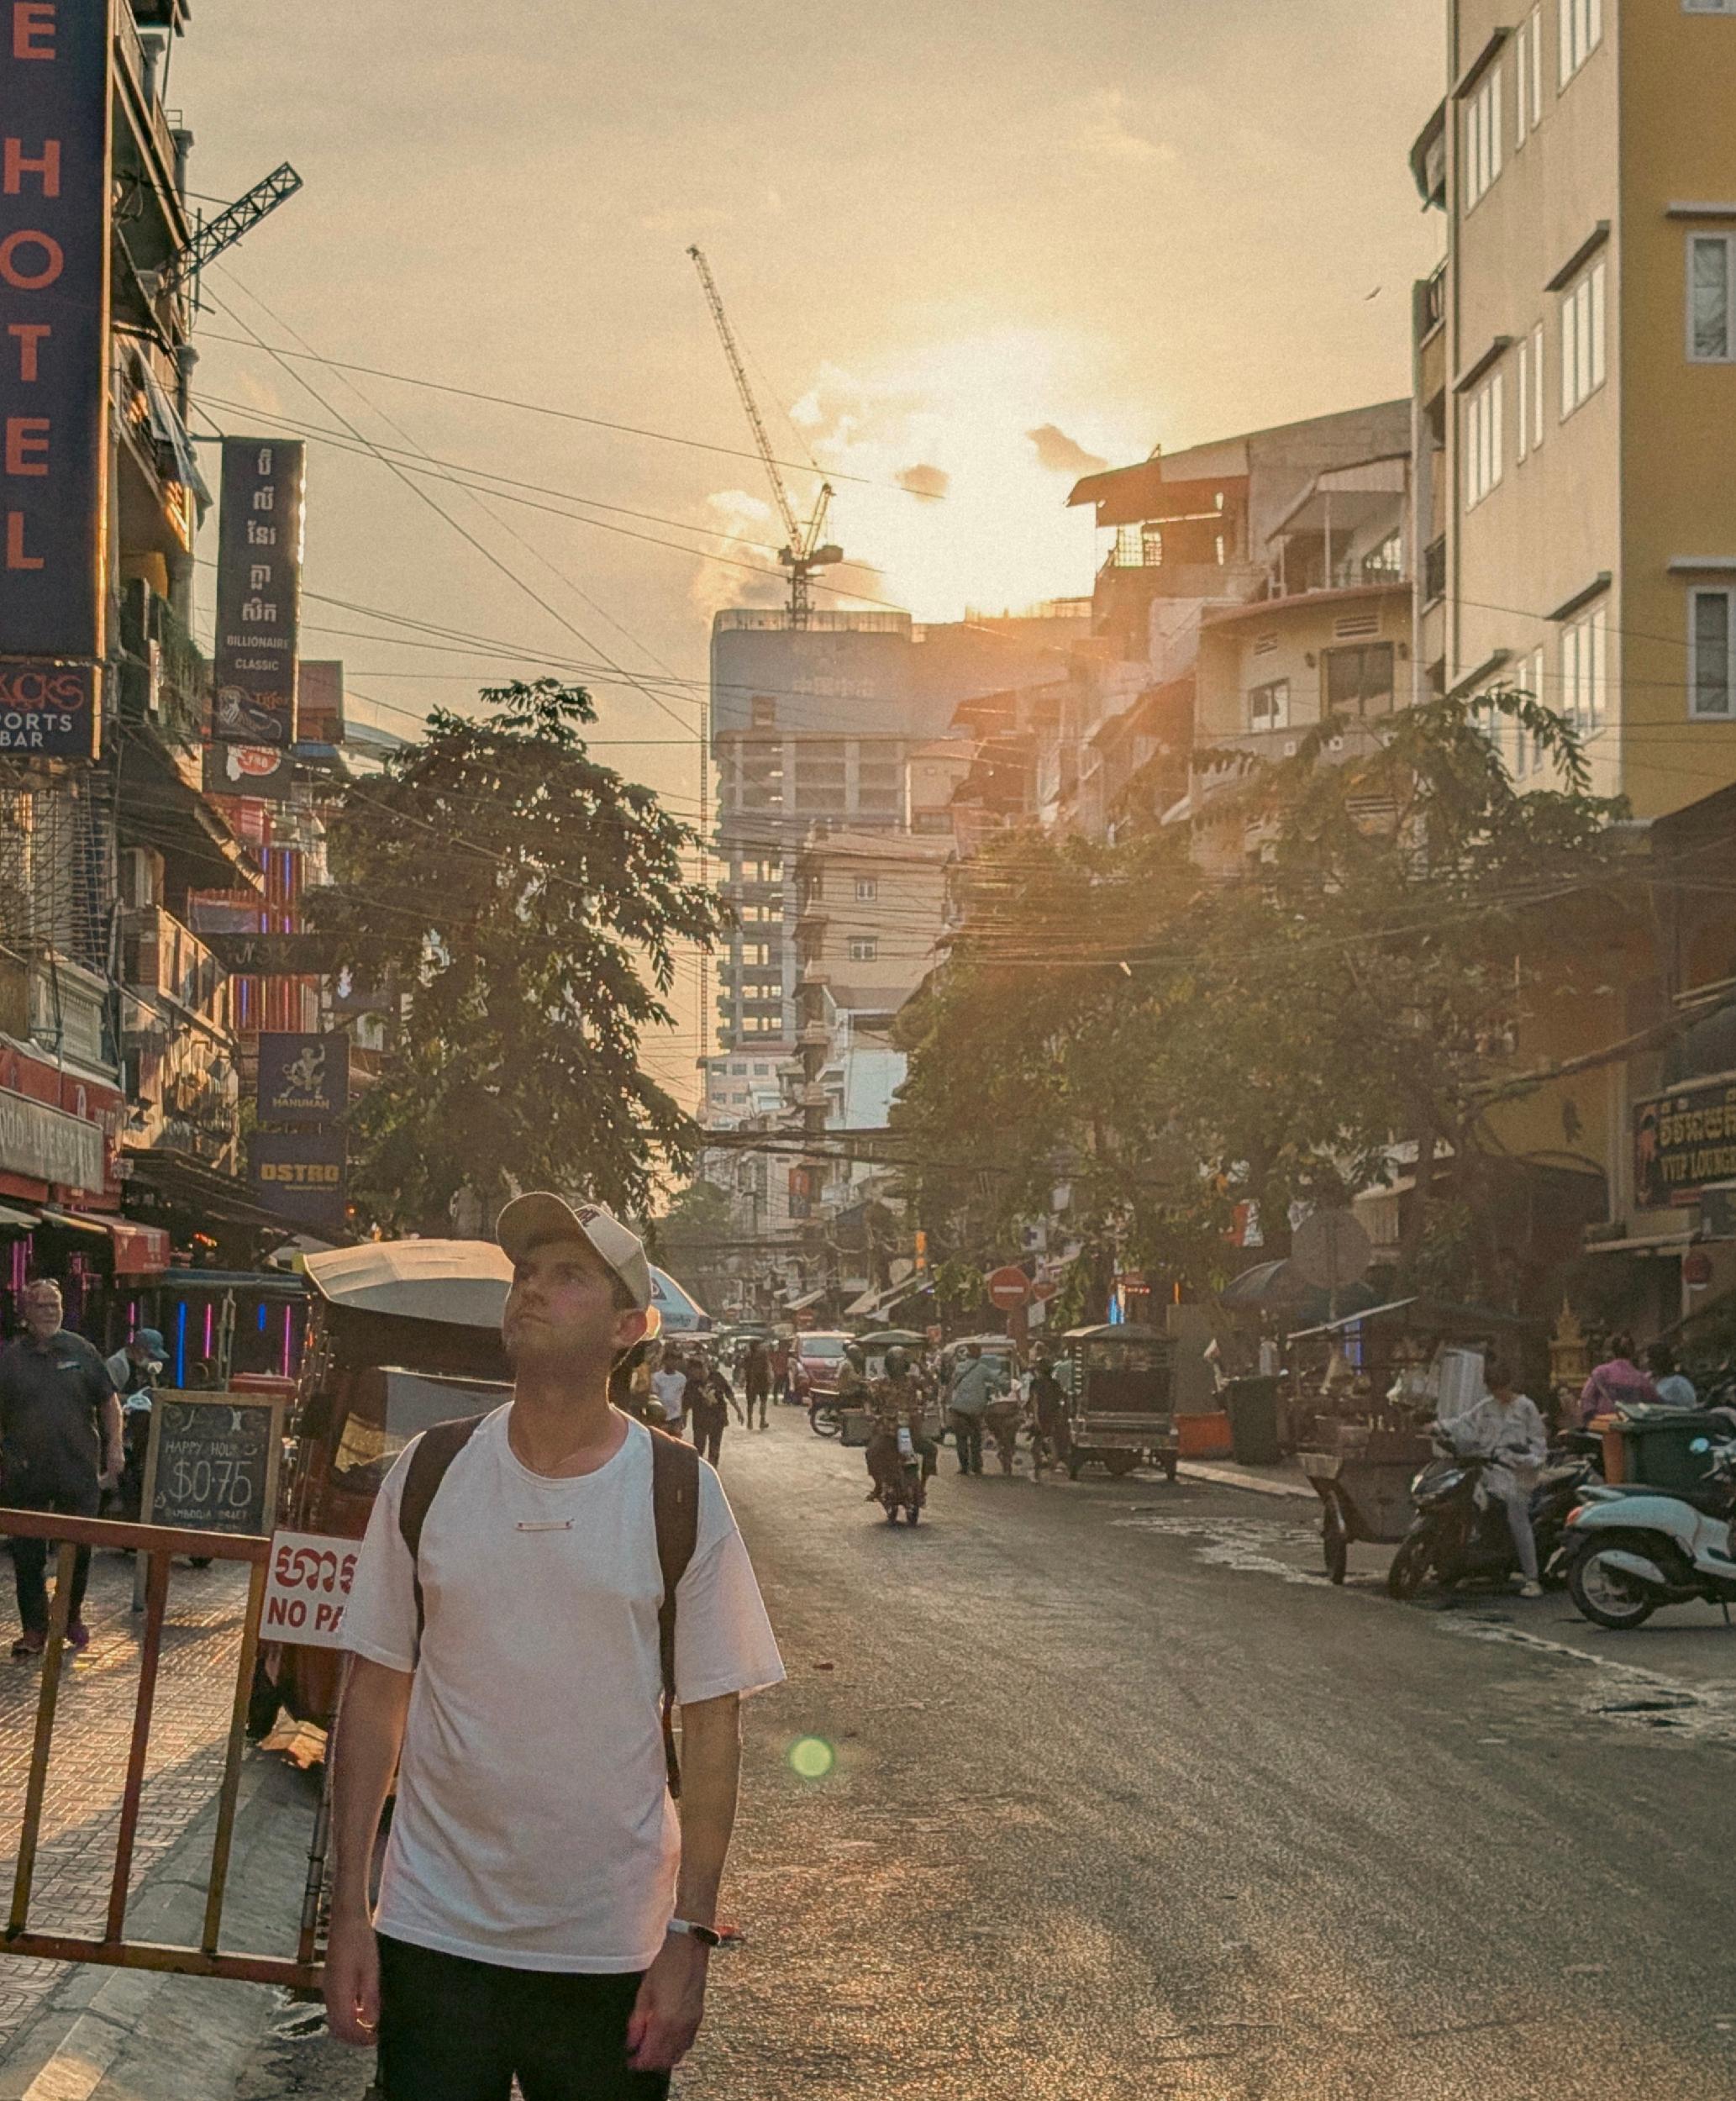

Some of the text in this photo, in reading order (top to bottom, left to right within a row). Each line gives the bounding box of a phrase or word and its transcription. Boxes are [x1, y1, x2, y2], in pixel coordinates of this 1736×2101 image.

[0, 138, 64, 570] HOTEL
[227, 635, 290, 650] BILLIONAIRE
[234, 658, 279, 671] CLASSIC
[0, 713, 72, 732] ORTS
[0, 730, 44, 747] BAR
[272, 1098, 330, 1110] HANUMAN
[260, 1163, 339, 1183] OSTRO
[165, 1440, 203, 1455] HAPPY
[168, 1458, 252, 1507] $0.75
[267, 1596, 308, 1628] NO
